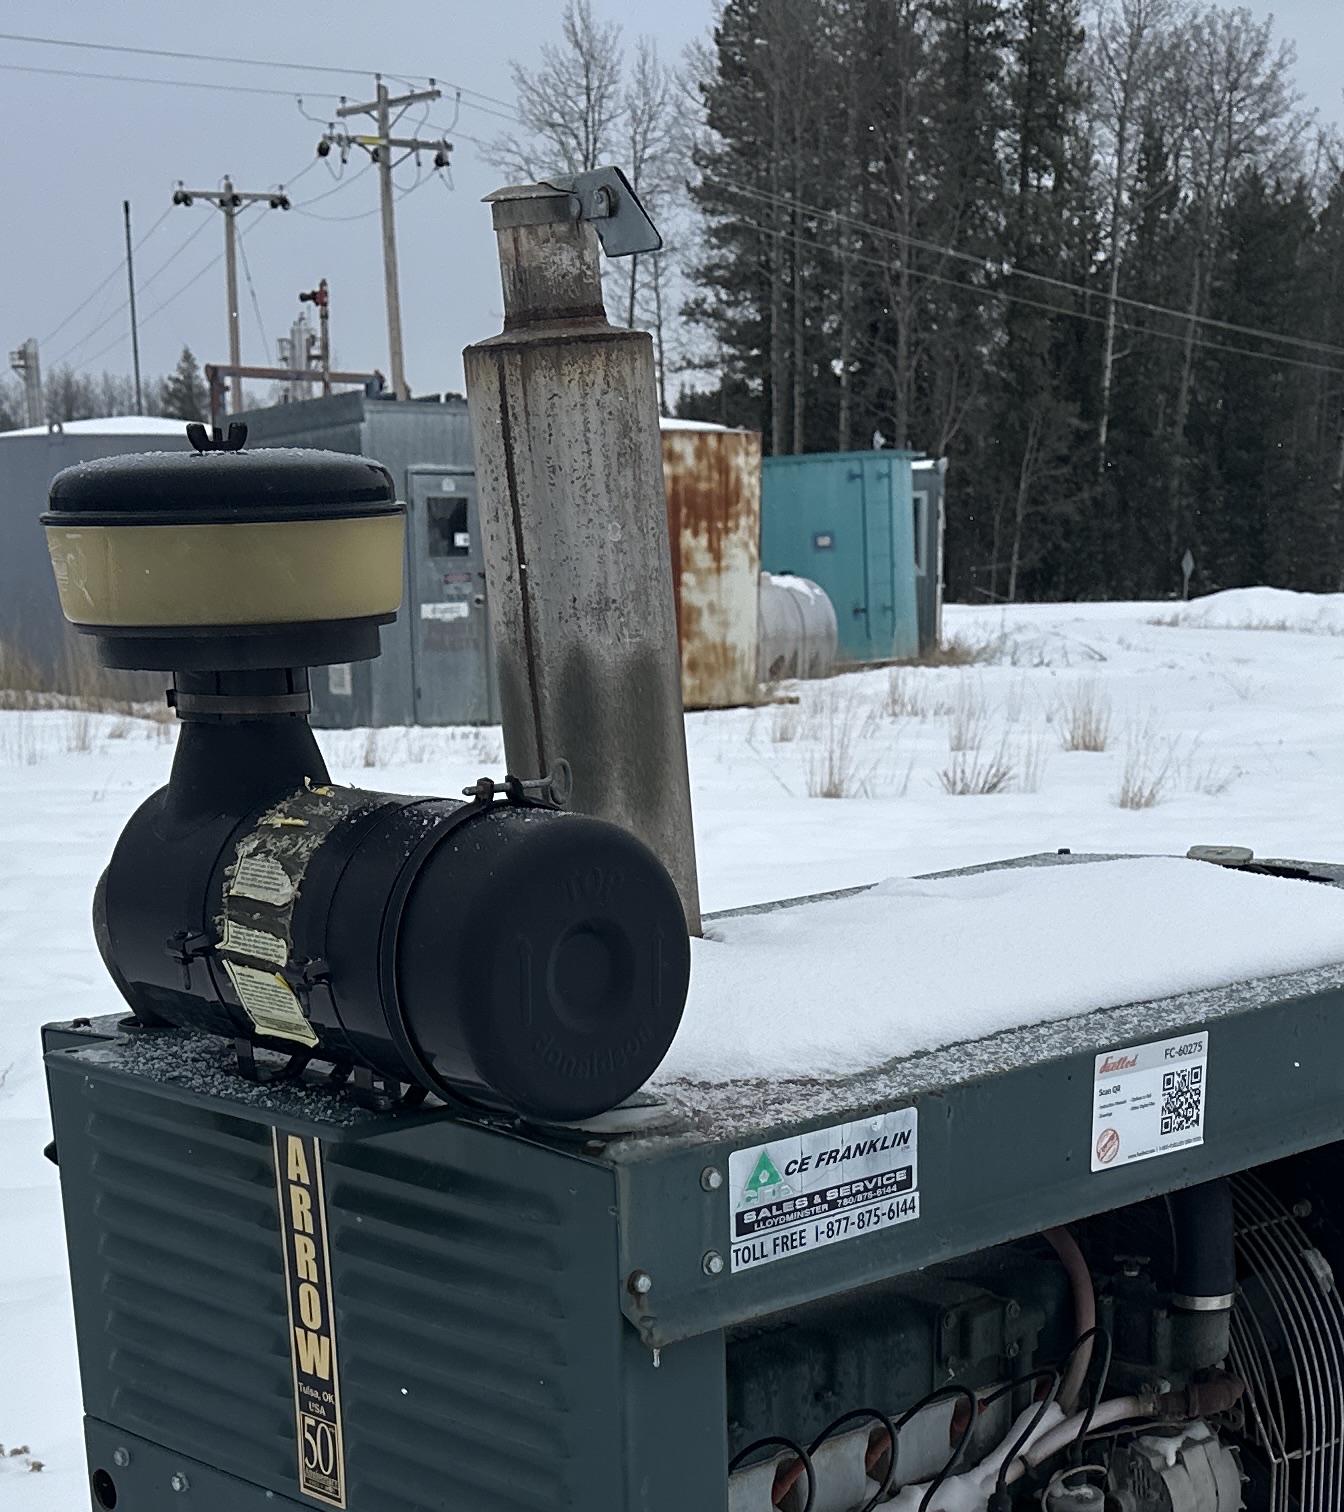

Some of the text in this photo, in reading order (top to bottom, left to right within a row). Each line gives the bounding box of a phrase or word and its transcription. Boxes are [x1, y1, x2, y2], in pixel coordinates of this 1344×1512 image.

[1164, 1041, 1203, 1060] FC-60275
[784, 1129, 912, 1176] CE FRANKLIN
[743, 1169, 908, 1224] SALES & SERVICE
[753, 1203, 829, 1231] LLOYDMINSTER
[732, 1196, 916, 1267] TOLL FREE 1-877-875-6144
[287, 1134, 330, 1382] ARROW
[308, 1400, 326, 1417] USA
